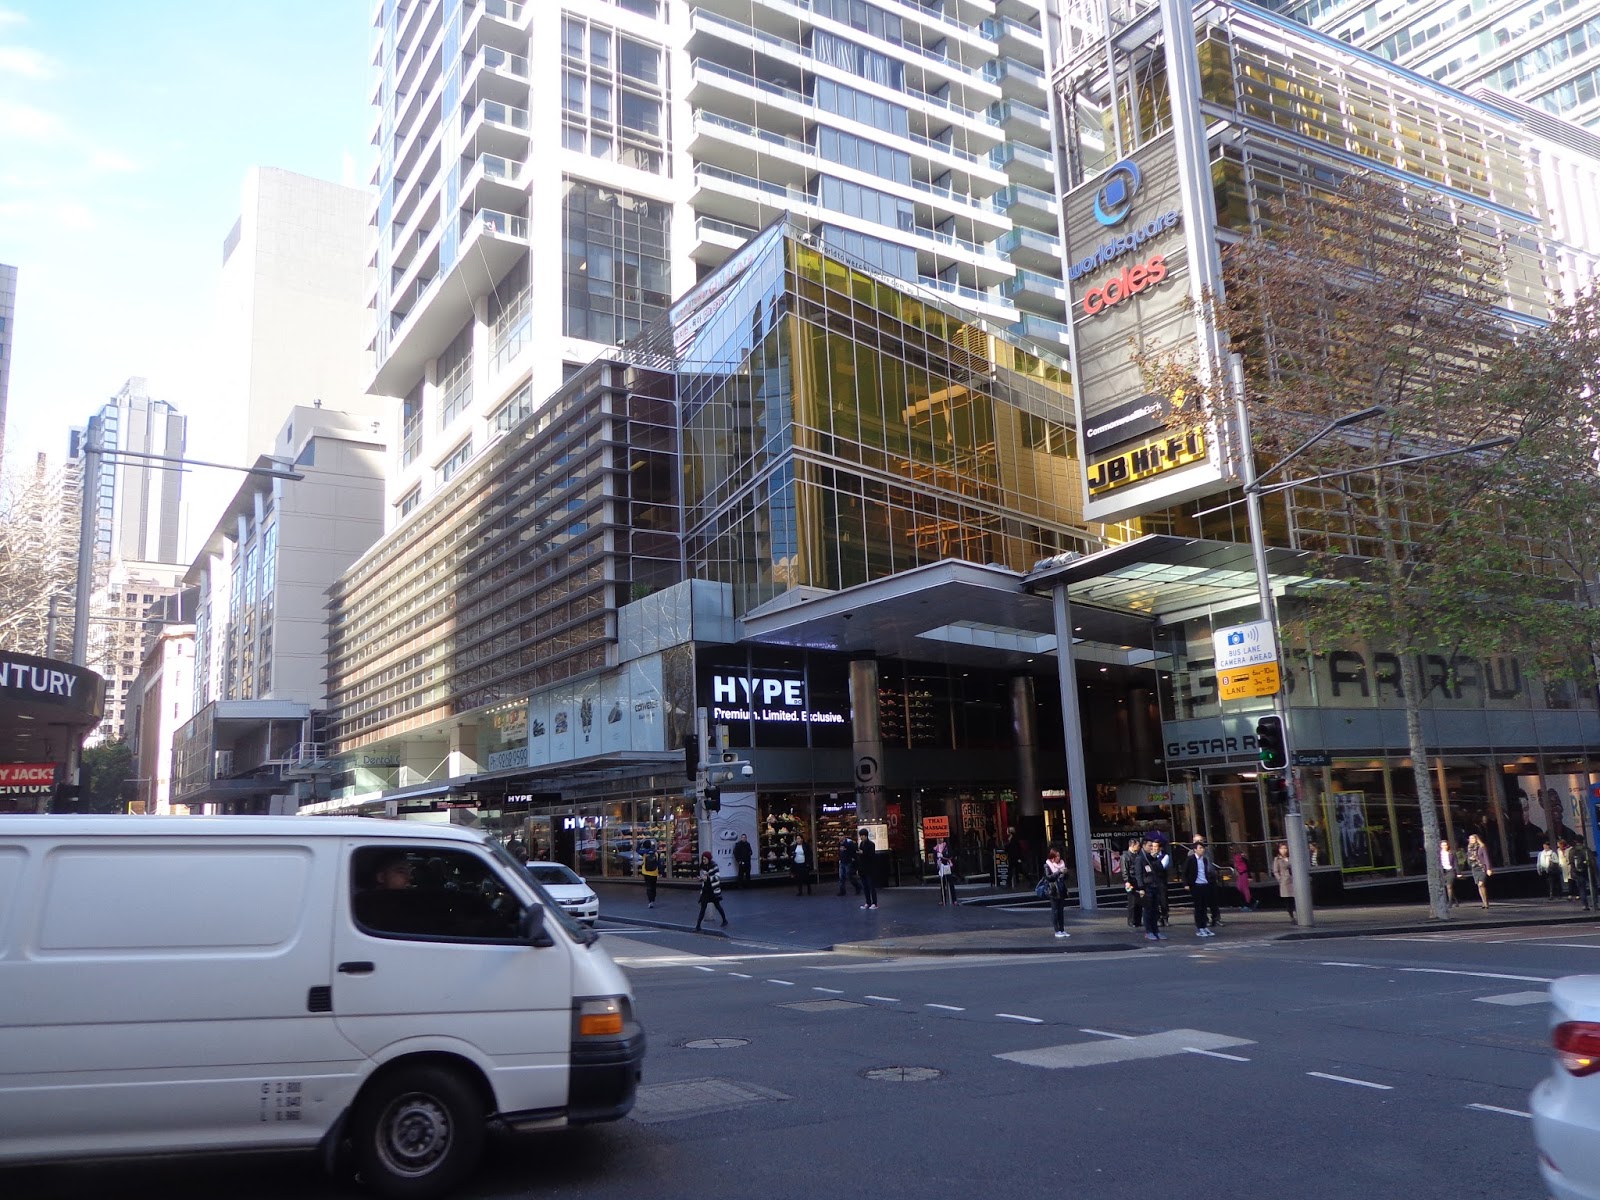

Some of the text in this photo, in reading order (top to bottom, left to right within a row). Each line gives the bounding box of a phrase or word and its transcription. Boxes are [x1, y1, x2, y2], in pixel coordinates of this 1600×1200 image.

[1069, 210, 1179, 280] worldsquare
[1083, 255, 1167, 314] coles
[1089, 457, 1127, 489] JB
[1229, 645, 1261, 657] BUS LANE
[1220, 652, 1272, 667] CAMERA AHEAD
[714, 675, 801, 705] HYPE
[1226, 686, 1246, 695] LANE
[763, 709, 799, 722] Limited.
[1167, 737, 1237, 756] G-STAR
[363, 755, 393, 765] Dental
[508, 794, 533, 802] HYPE
